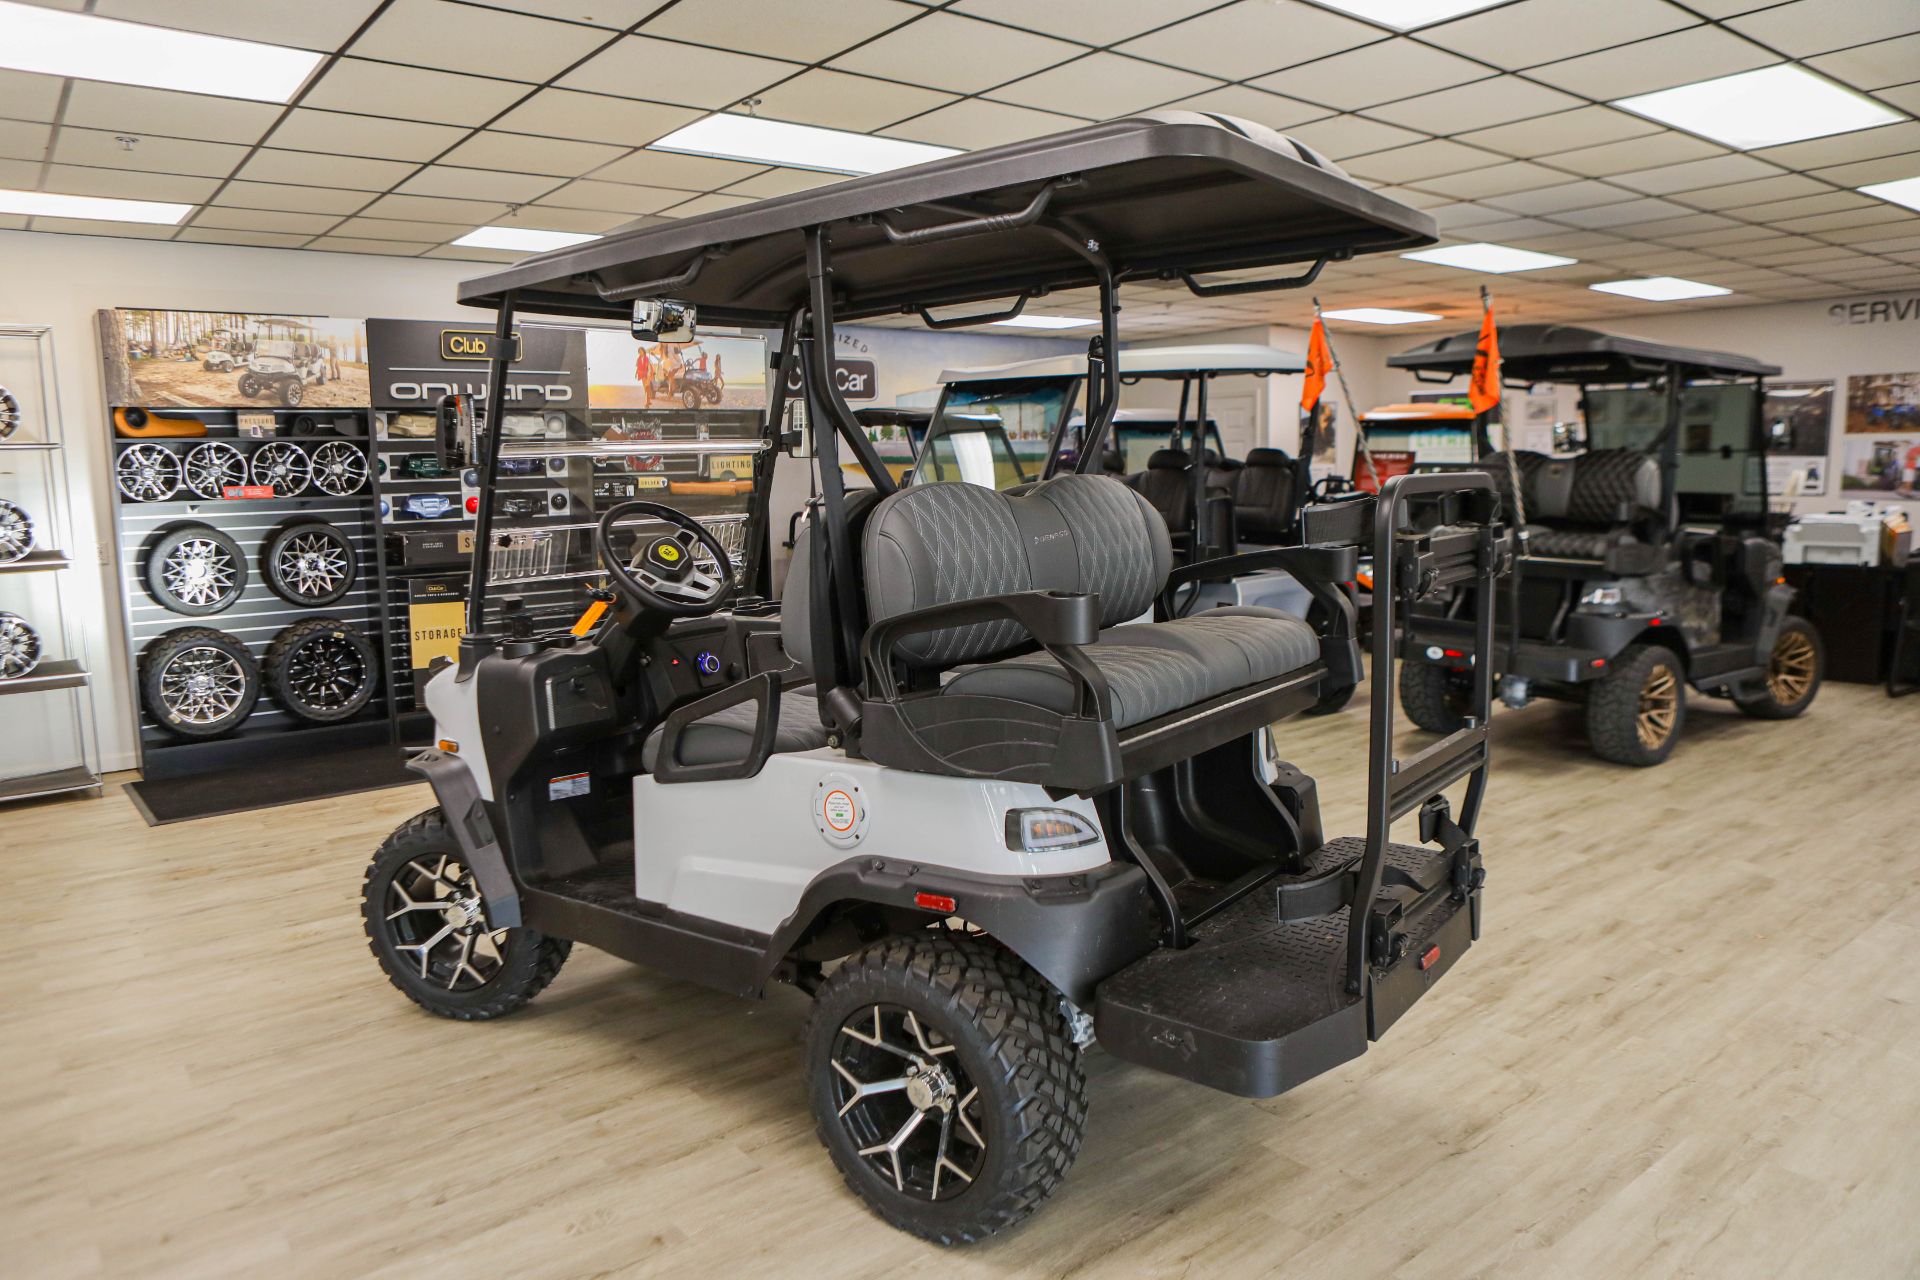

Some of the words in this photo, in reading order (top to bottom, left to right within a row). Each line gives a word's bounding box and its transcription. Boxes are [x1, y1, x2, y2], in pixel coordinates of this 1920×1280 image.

[449, 336, 487, 354] Club
[835, 367, 868, 392] Car
[711, 460, 752, 470] LIGHTING
[415, 628, 463, 641] STORAGE
